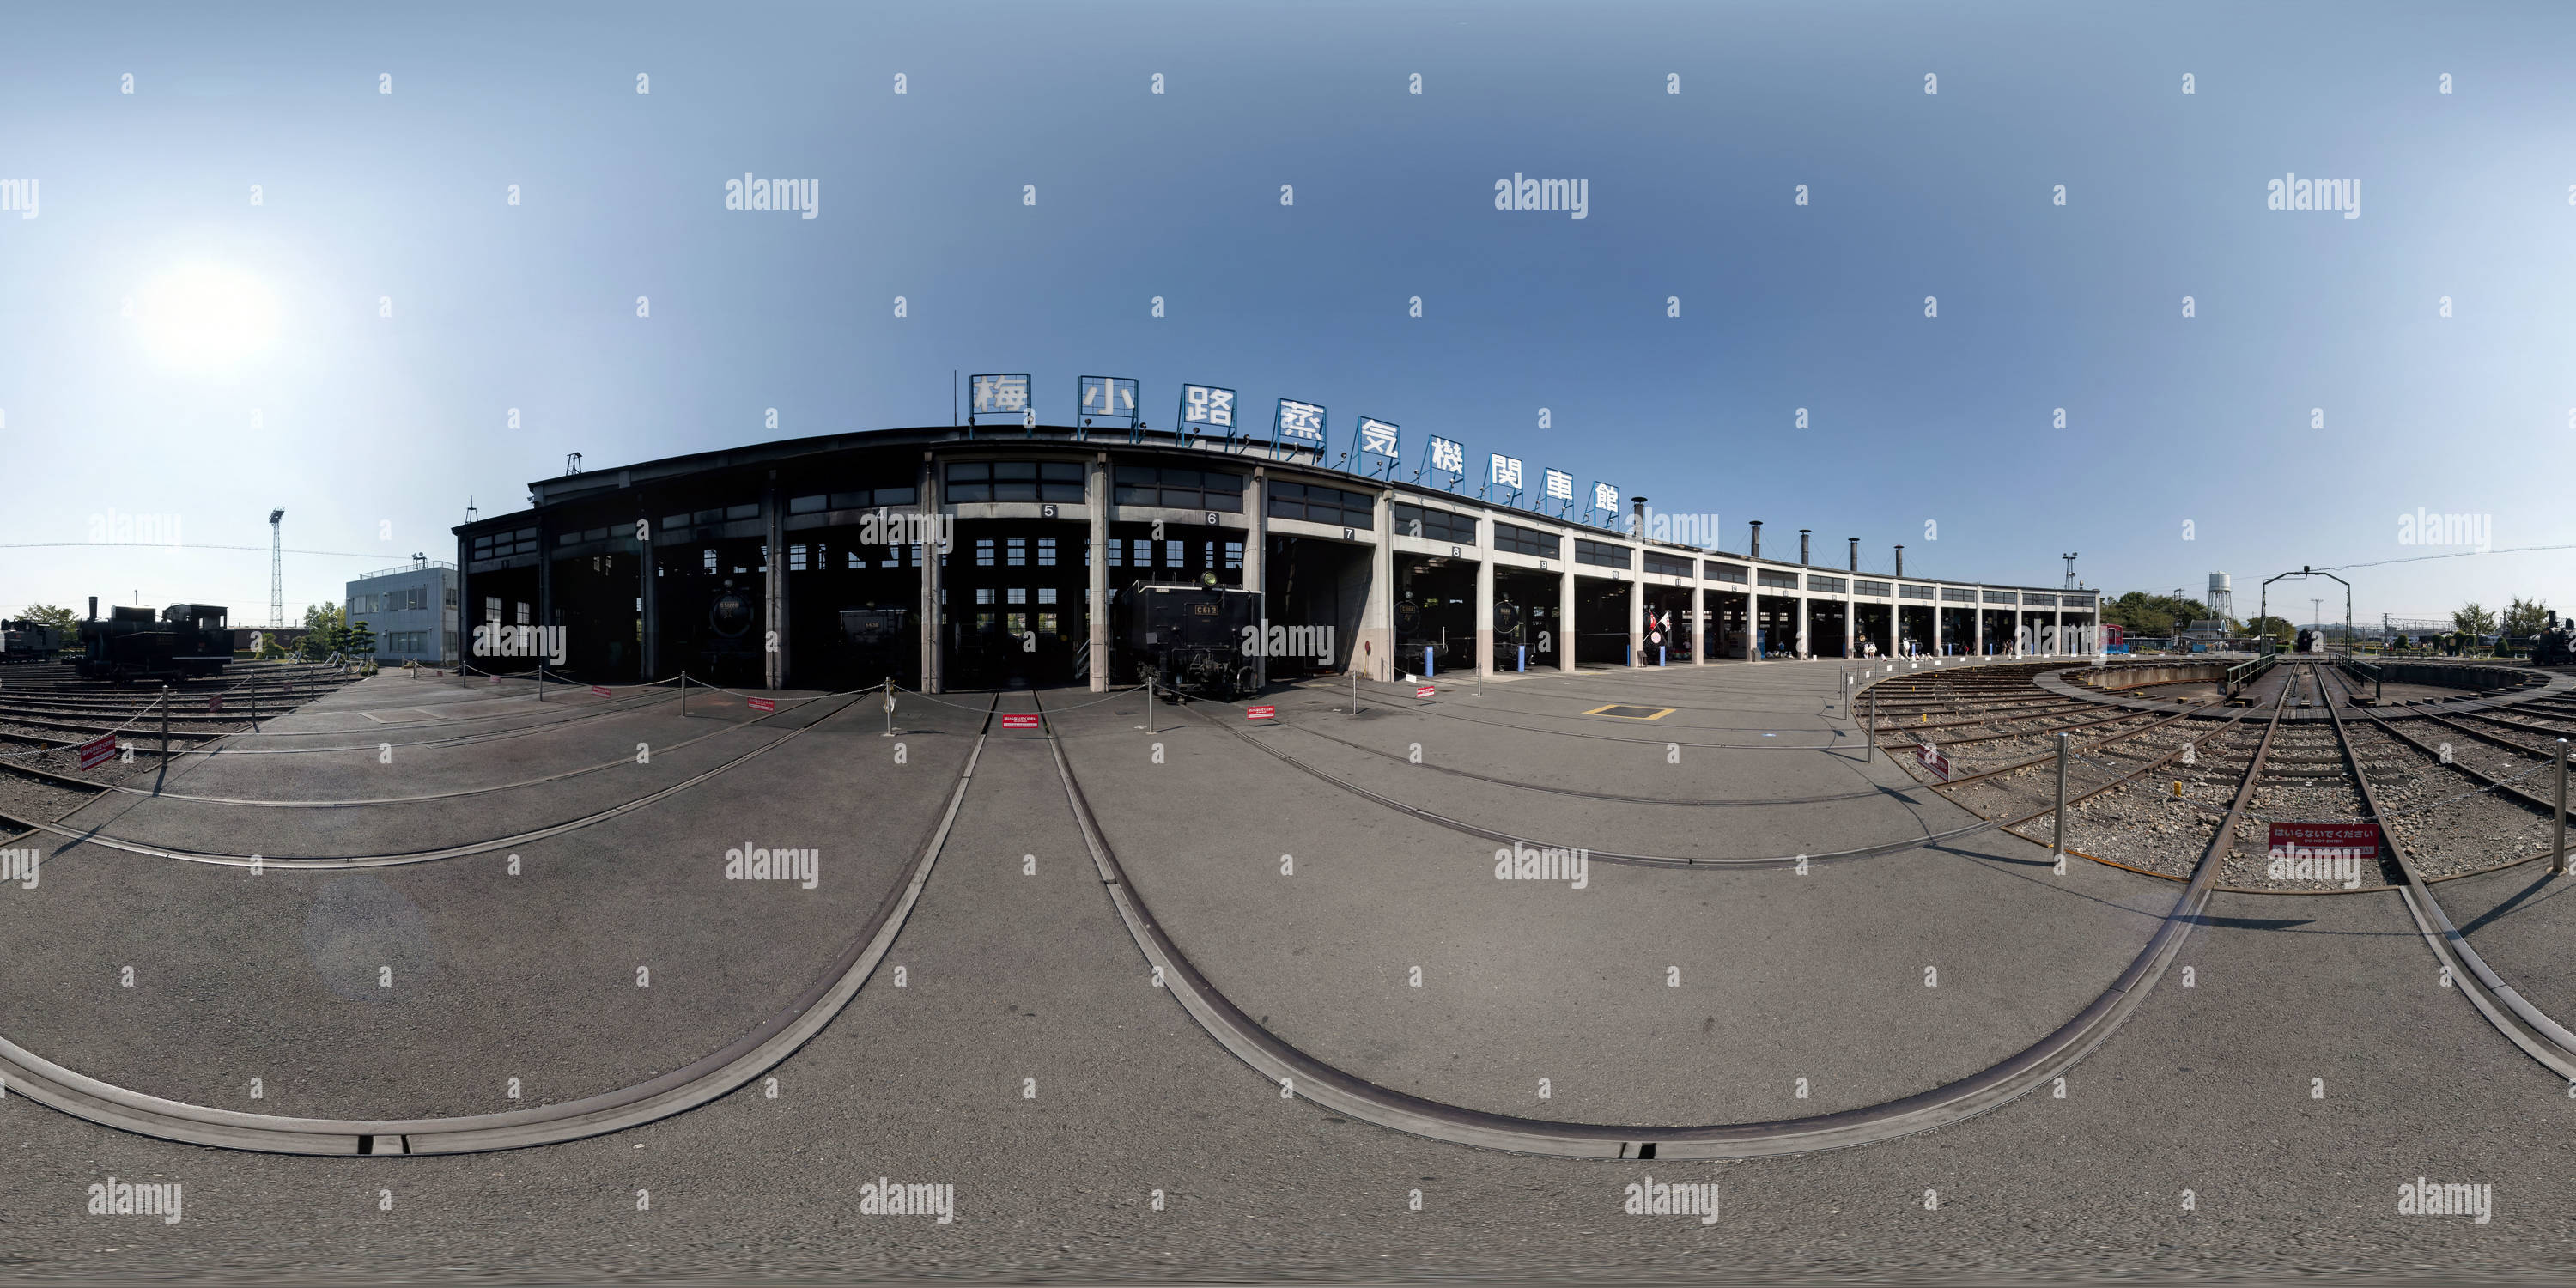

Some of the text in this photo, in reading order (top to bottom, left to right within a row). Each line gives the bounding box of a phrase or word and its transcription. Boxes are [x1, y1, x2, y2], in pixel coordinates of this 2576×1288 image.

[1044, 505, 1054, 517] 5
[1207, 513, 1217, 524] 6
[1346, 529, 1352, 538] 7
[1453, 547, 1460, 556] 8
[2275, 829, 2373, 838] はいらないでください
